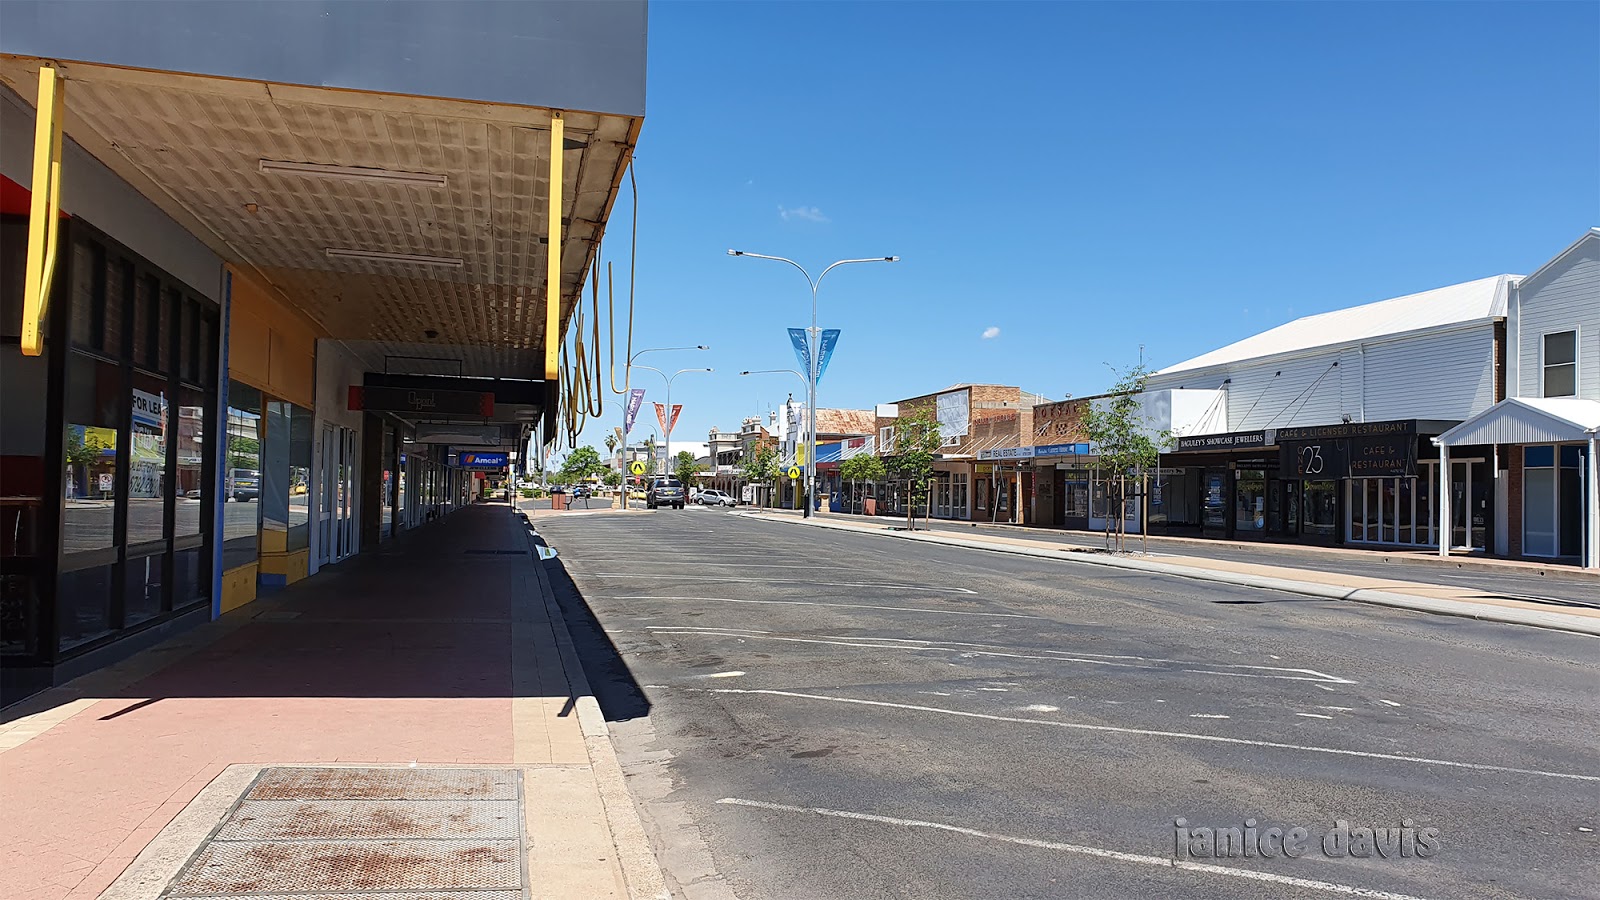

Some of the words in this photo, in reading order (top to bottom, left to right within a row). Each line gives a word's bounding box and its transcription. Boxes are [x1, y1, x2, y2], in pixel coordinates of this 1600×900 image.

[132, 396, 147, 411] FOR
[148, 400, 169, 418] LEAE
[1309, 427, 1348, 437] LICENSED
[1352, 422, 1408, 434] RESTAURANT
[1206, 436, 1233, 446] SHOWCASE
[1234, 435, 1263, 446] JEWELLERS
[993, 449, 1002, 458] REAL
[1003, 448, 1017, 458] ESTATE
[1388, 447, 1395, 455] &
[1303, 445, 1324, 474] 23
